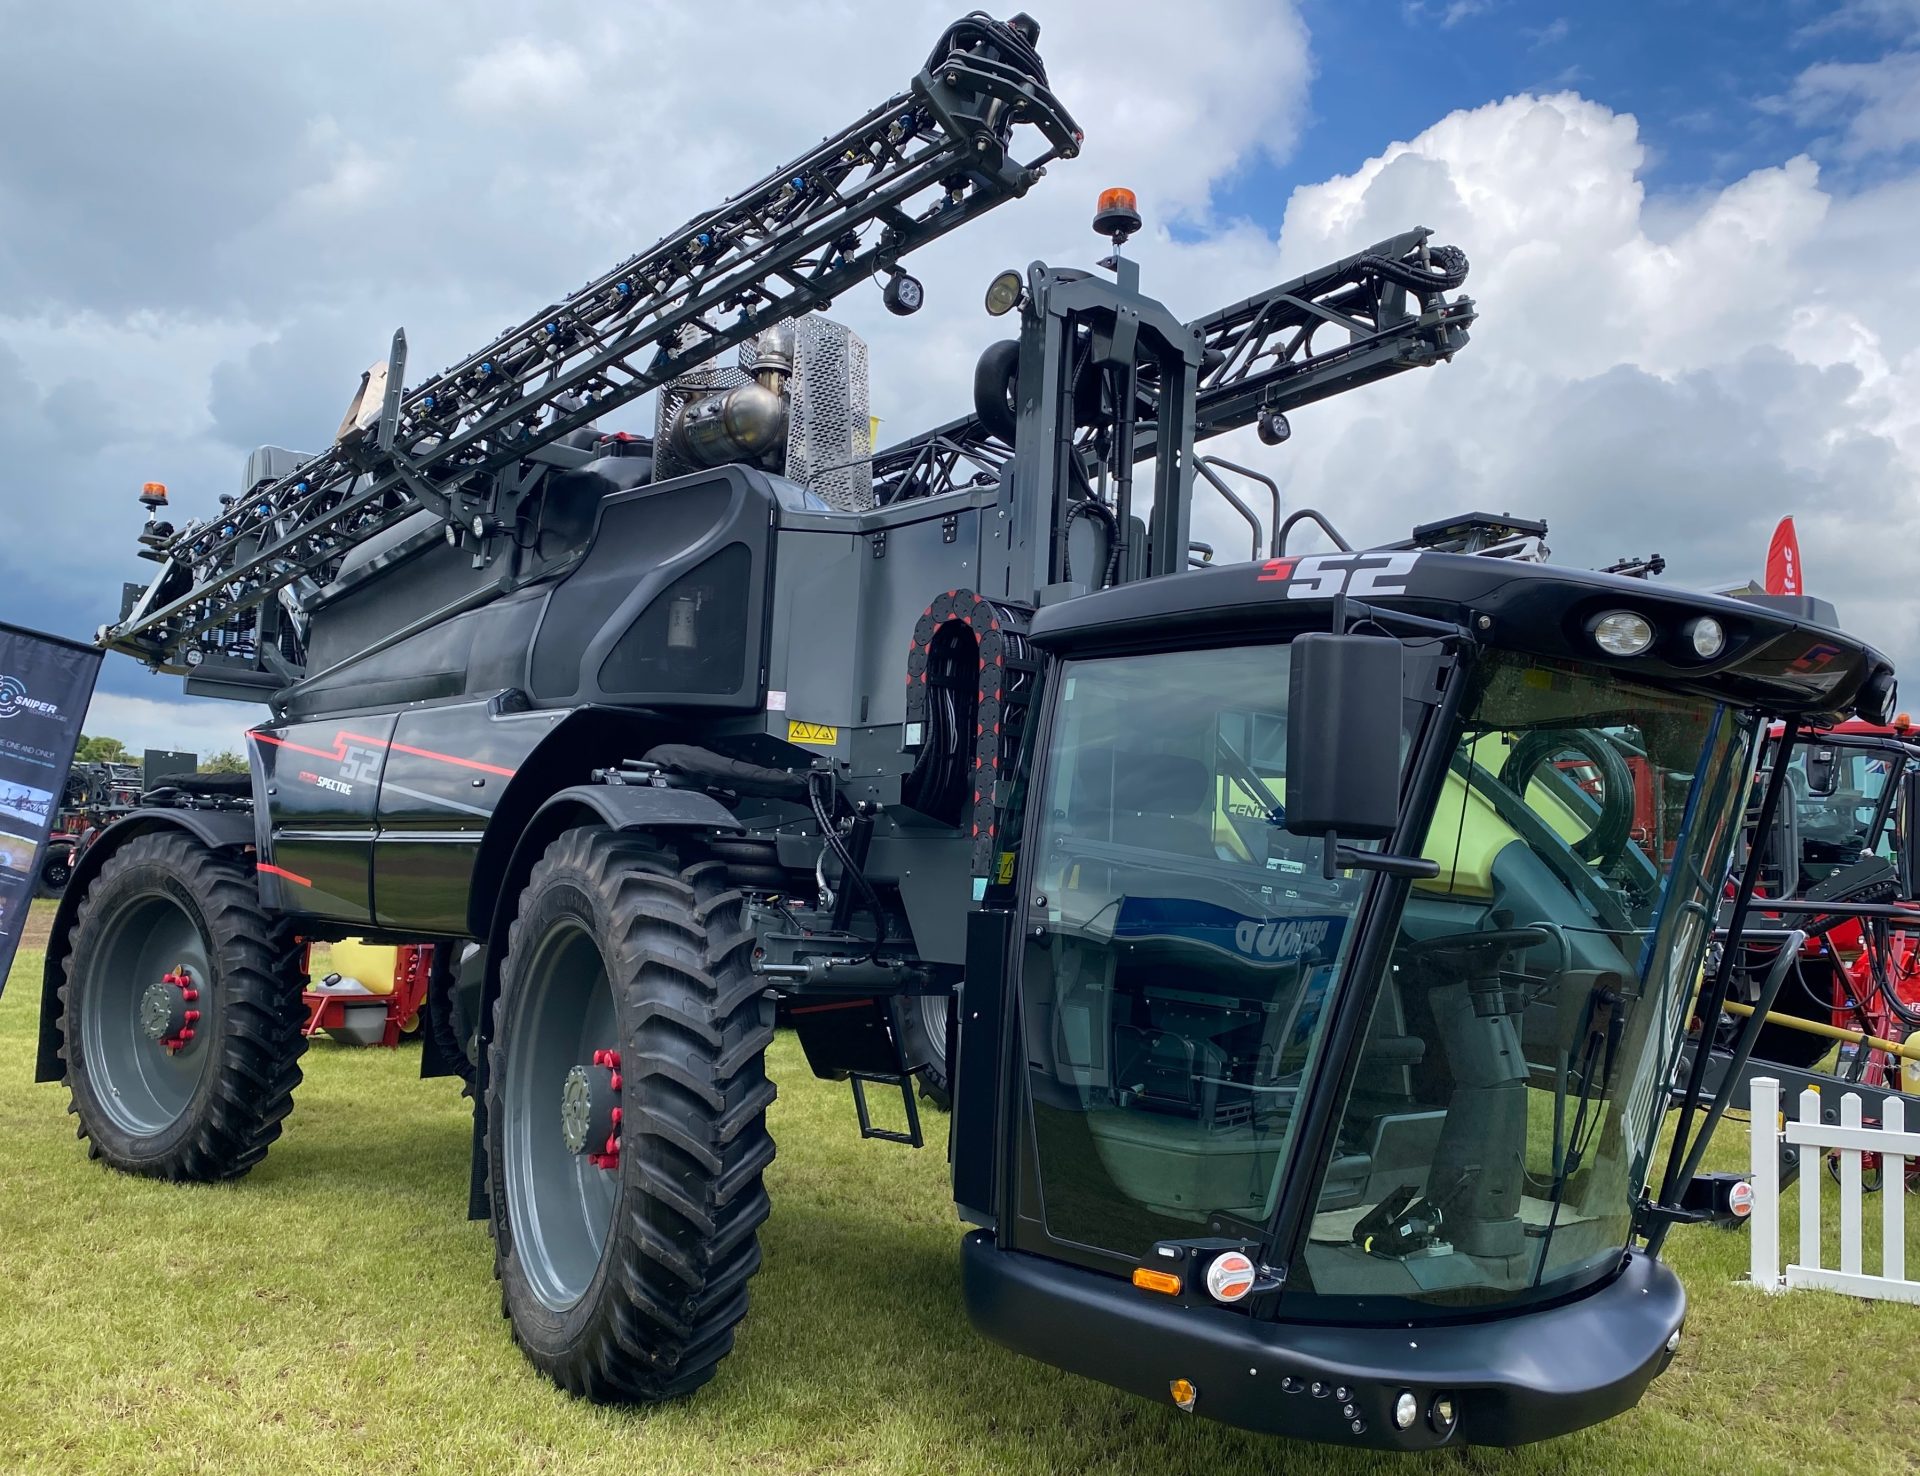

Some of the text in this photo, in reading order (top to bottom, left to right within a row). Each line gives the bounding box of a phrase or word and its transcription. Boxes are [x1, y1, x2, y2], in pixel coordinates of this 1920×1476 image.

[14, 696, 58, 714] SNIPER
[315, 775, 353, 796] SPECTRE
[492, 1148, 508, 1231] AGRIBIB
